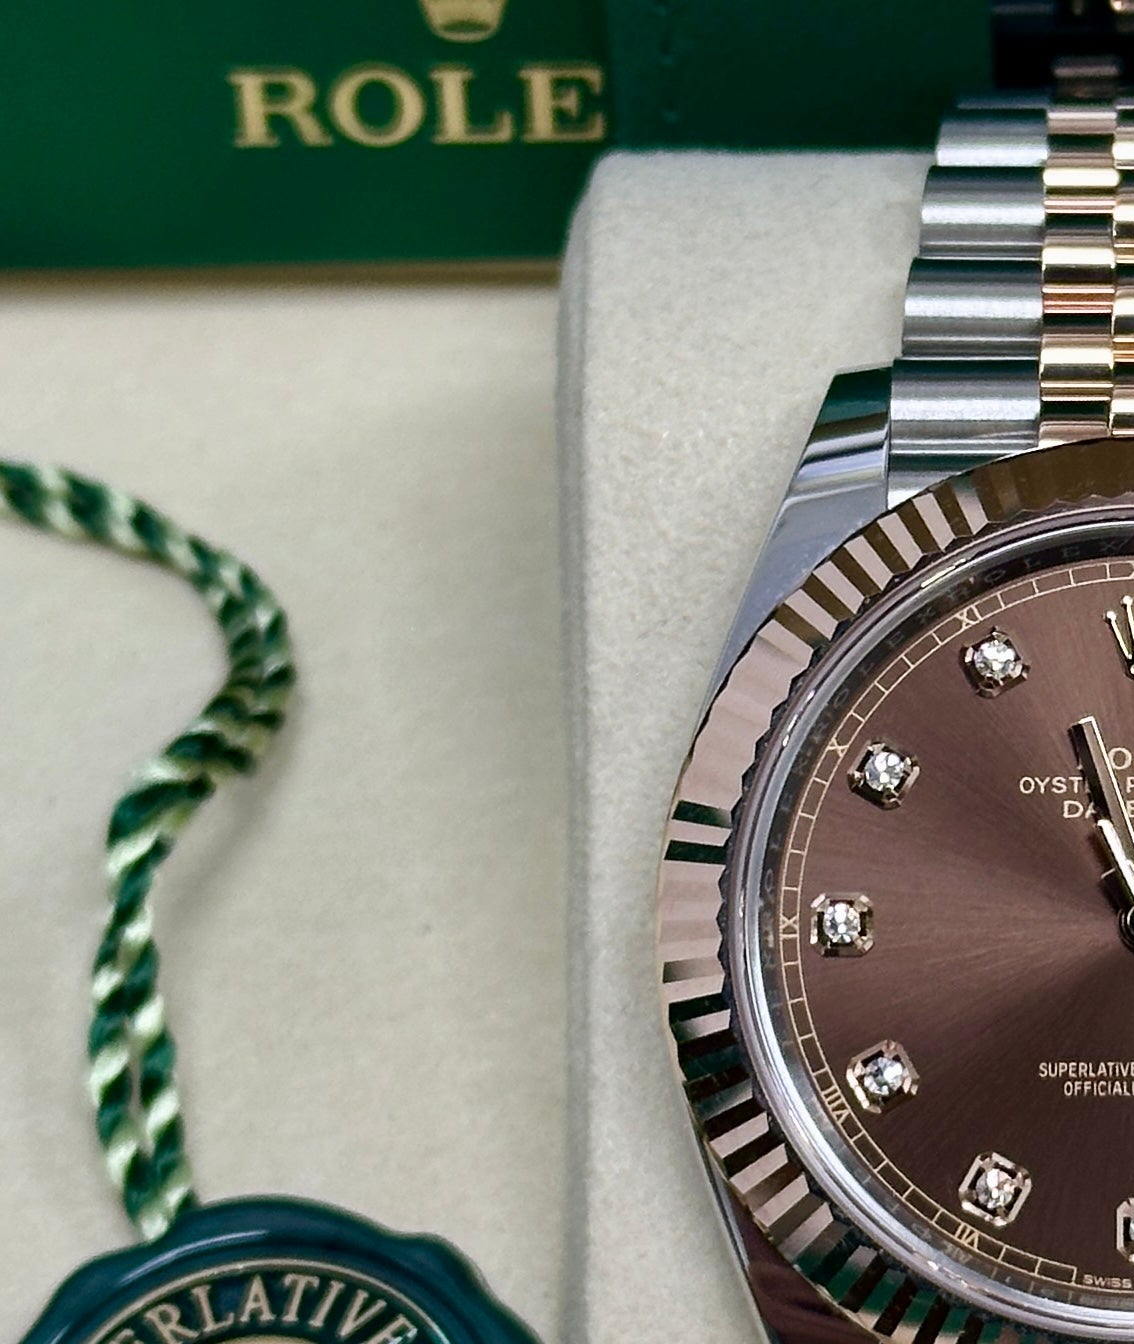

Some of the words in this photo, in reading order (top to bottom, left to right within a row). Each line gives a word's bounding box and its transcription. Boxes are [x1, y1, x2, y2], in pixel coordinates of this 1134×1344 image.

[227, 60, 606, 148] ROLE
[955, 605, 982, 632] XI
[1019, 776, 1091, 794] OYST
[1083, 1274, 1132, 1289] SWISS
